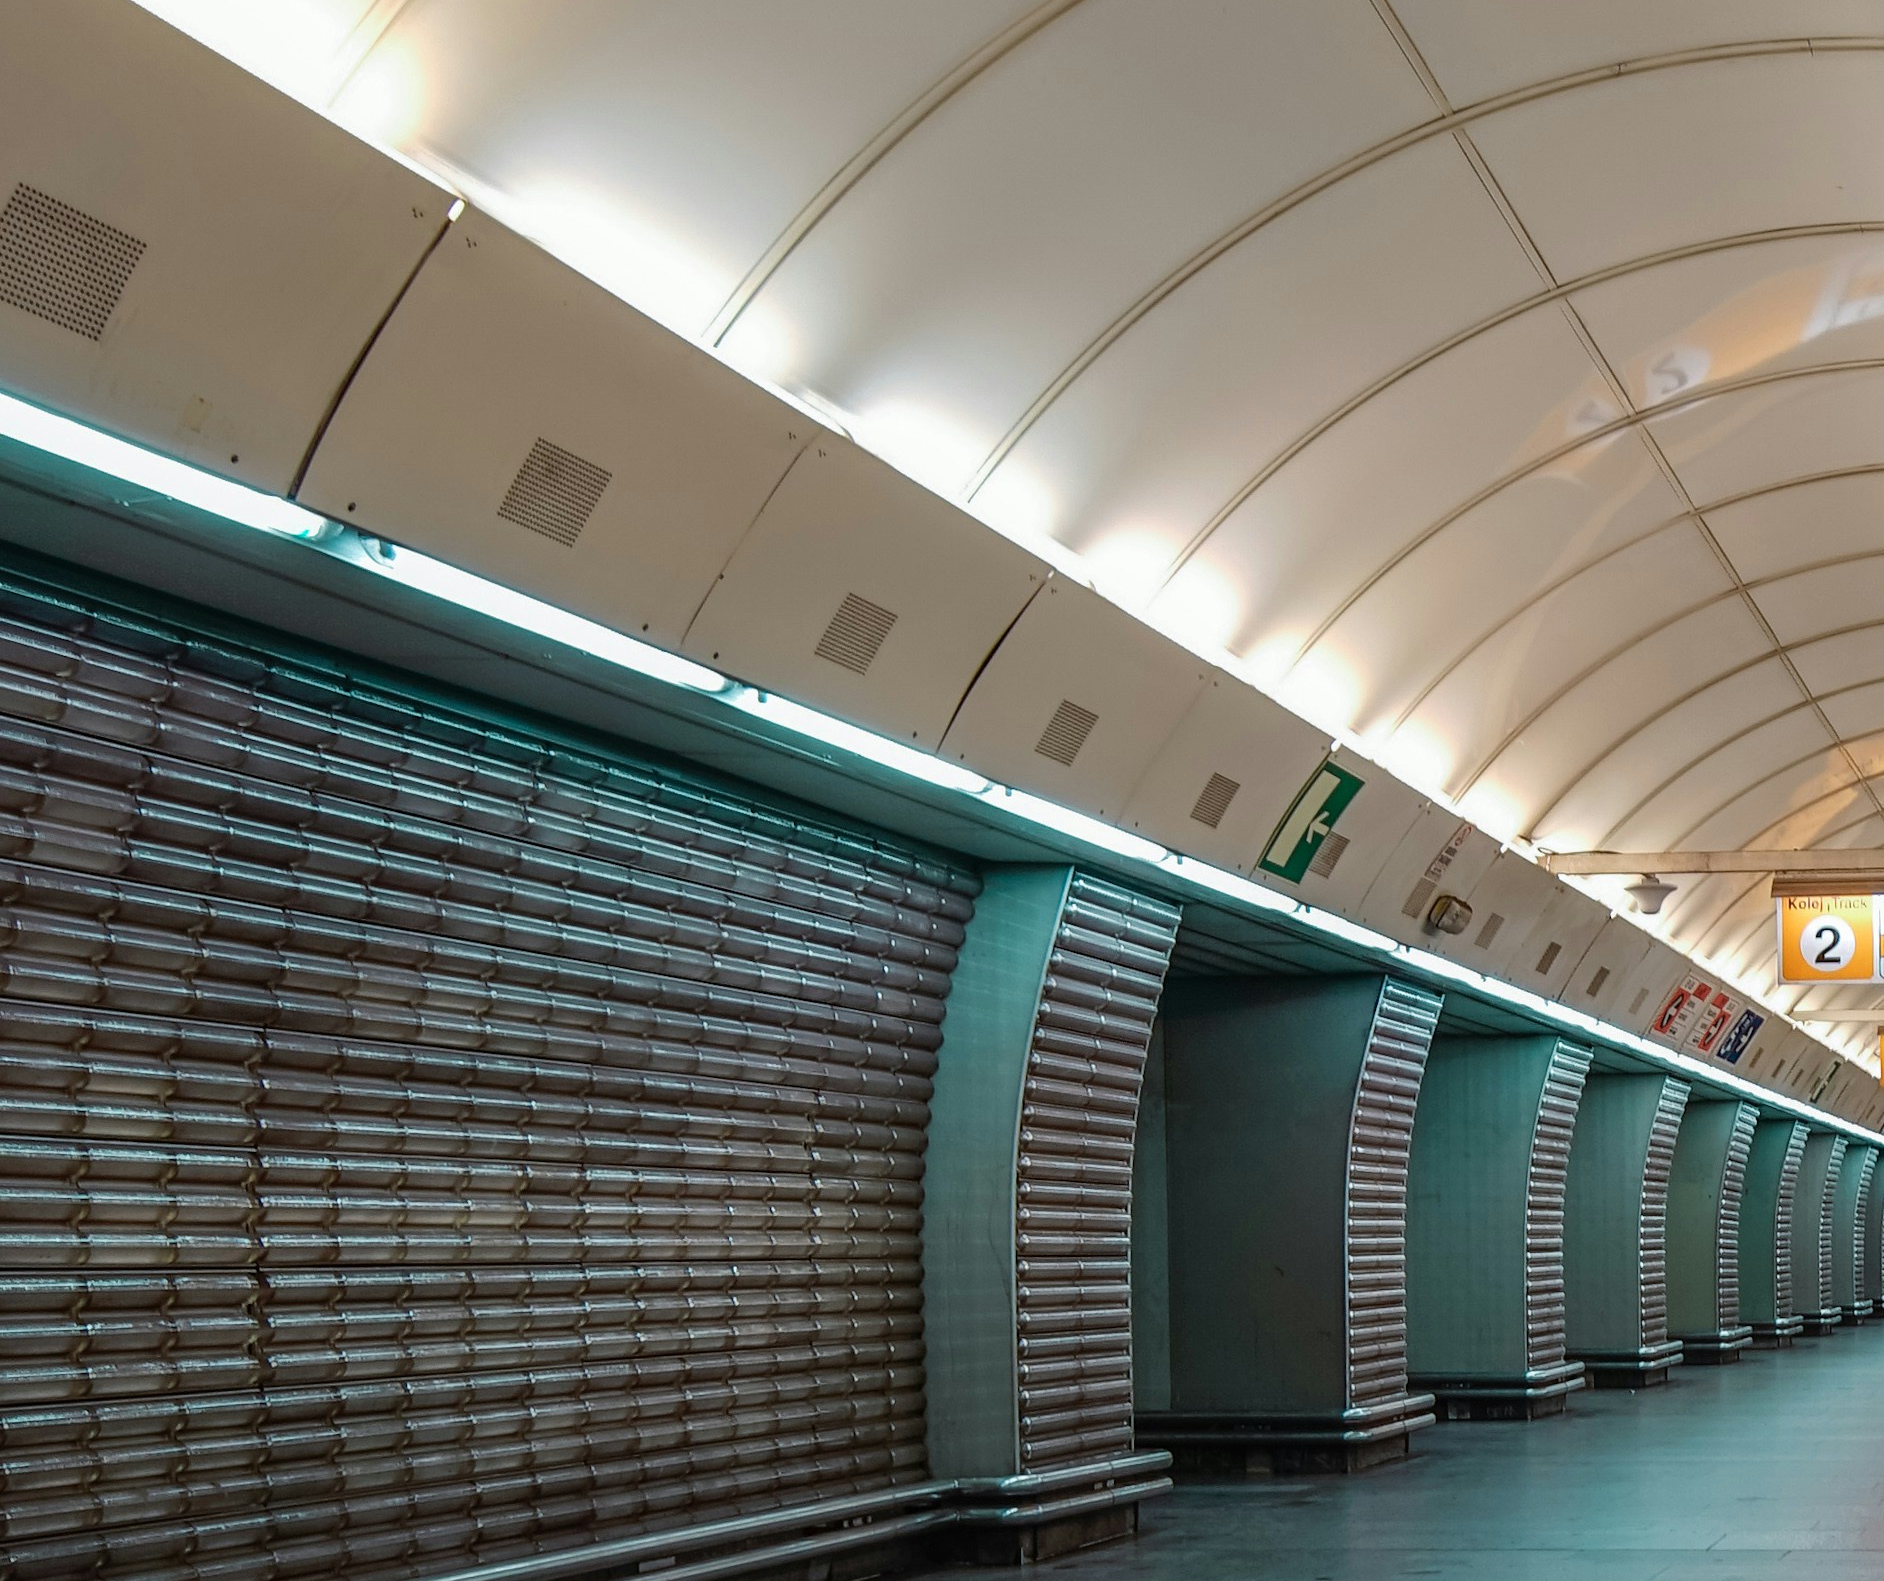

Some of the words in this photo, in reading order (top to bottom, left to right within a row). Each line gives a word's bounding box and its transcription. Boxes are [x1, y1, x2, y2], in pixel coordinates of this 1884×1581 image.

[1788, 896, 1823, 912] Kolej
[1832, 896, 1868, 909] Track
[1815, 926, 1841, 964] 2
